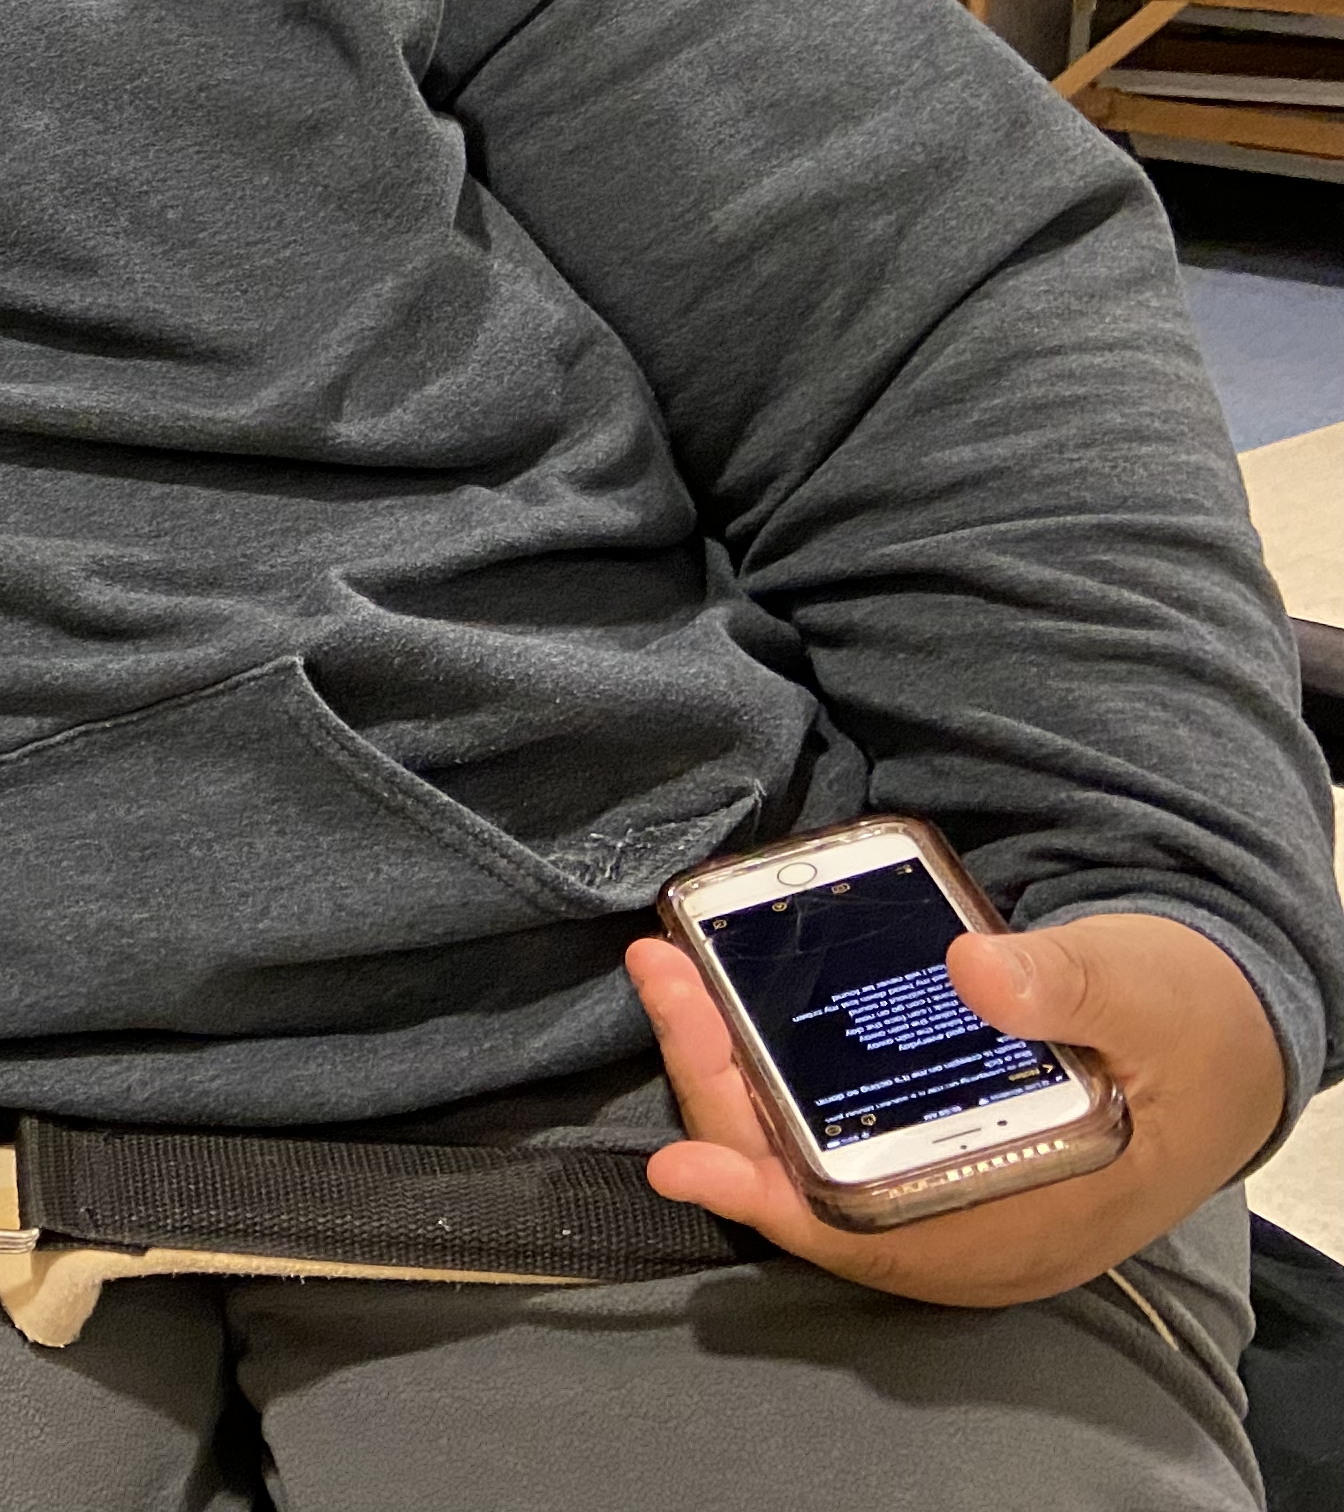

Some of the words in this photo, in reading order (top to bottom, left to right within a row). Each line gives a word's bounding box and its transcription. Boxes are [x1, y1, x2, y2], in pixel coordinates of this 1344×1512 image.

[832, 989, 861, 1002] found
[849, 1003, 879, 1018] sound
[855, 1014, 875, 1023] now
[846, 1027, 864, 1036] day
[860, 1030, 886, 1042] away
[916, 1027, 934, 1035] the
[867, 1038, 894, 1050] away
[899, 1033, 944, 1051] everyday
[994, 1041, 1026, 1054] Death
[928, 1065, 943, 1073] on
[860, 1080, 893, 1093] acting
